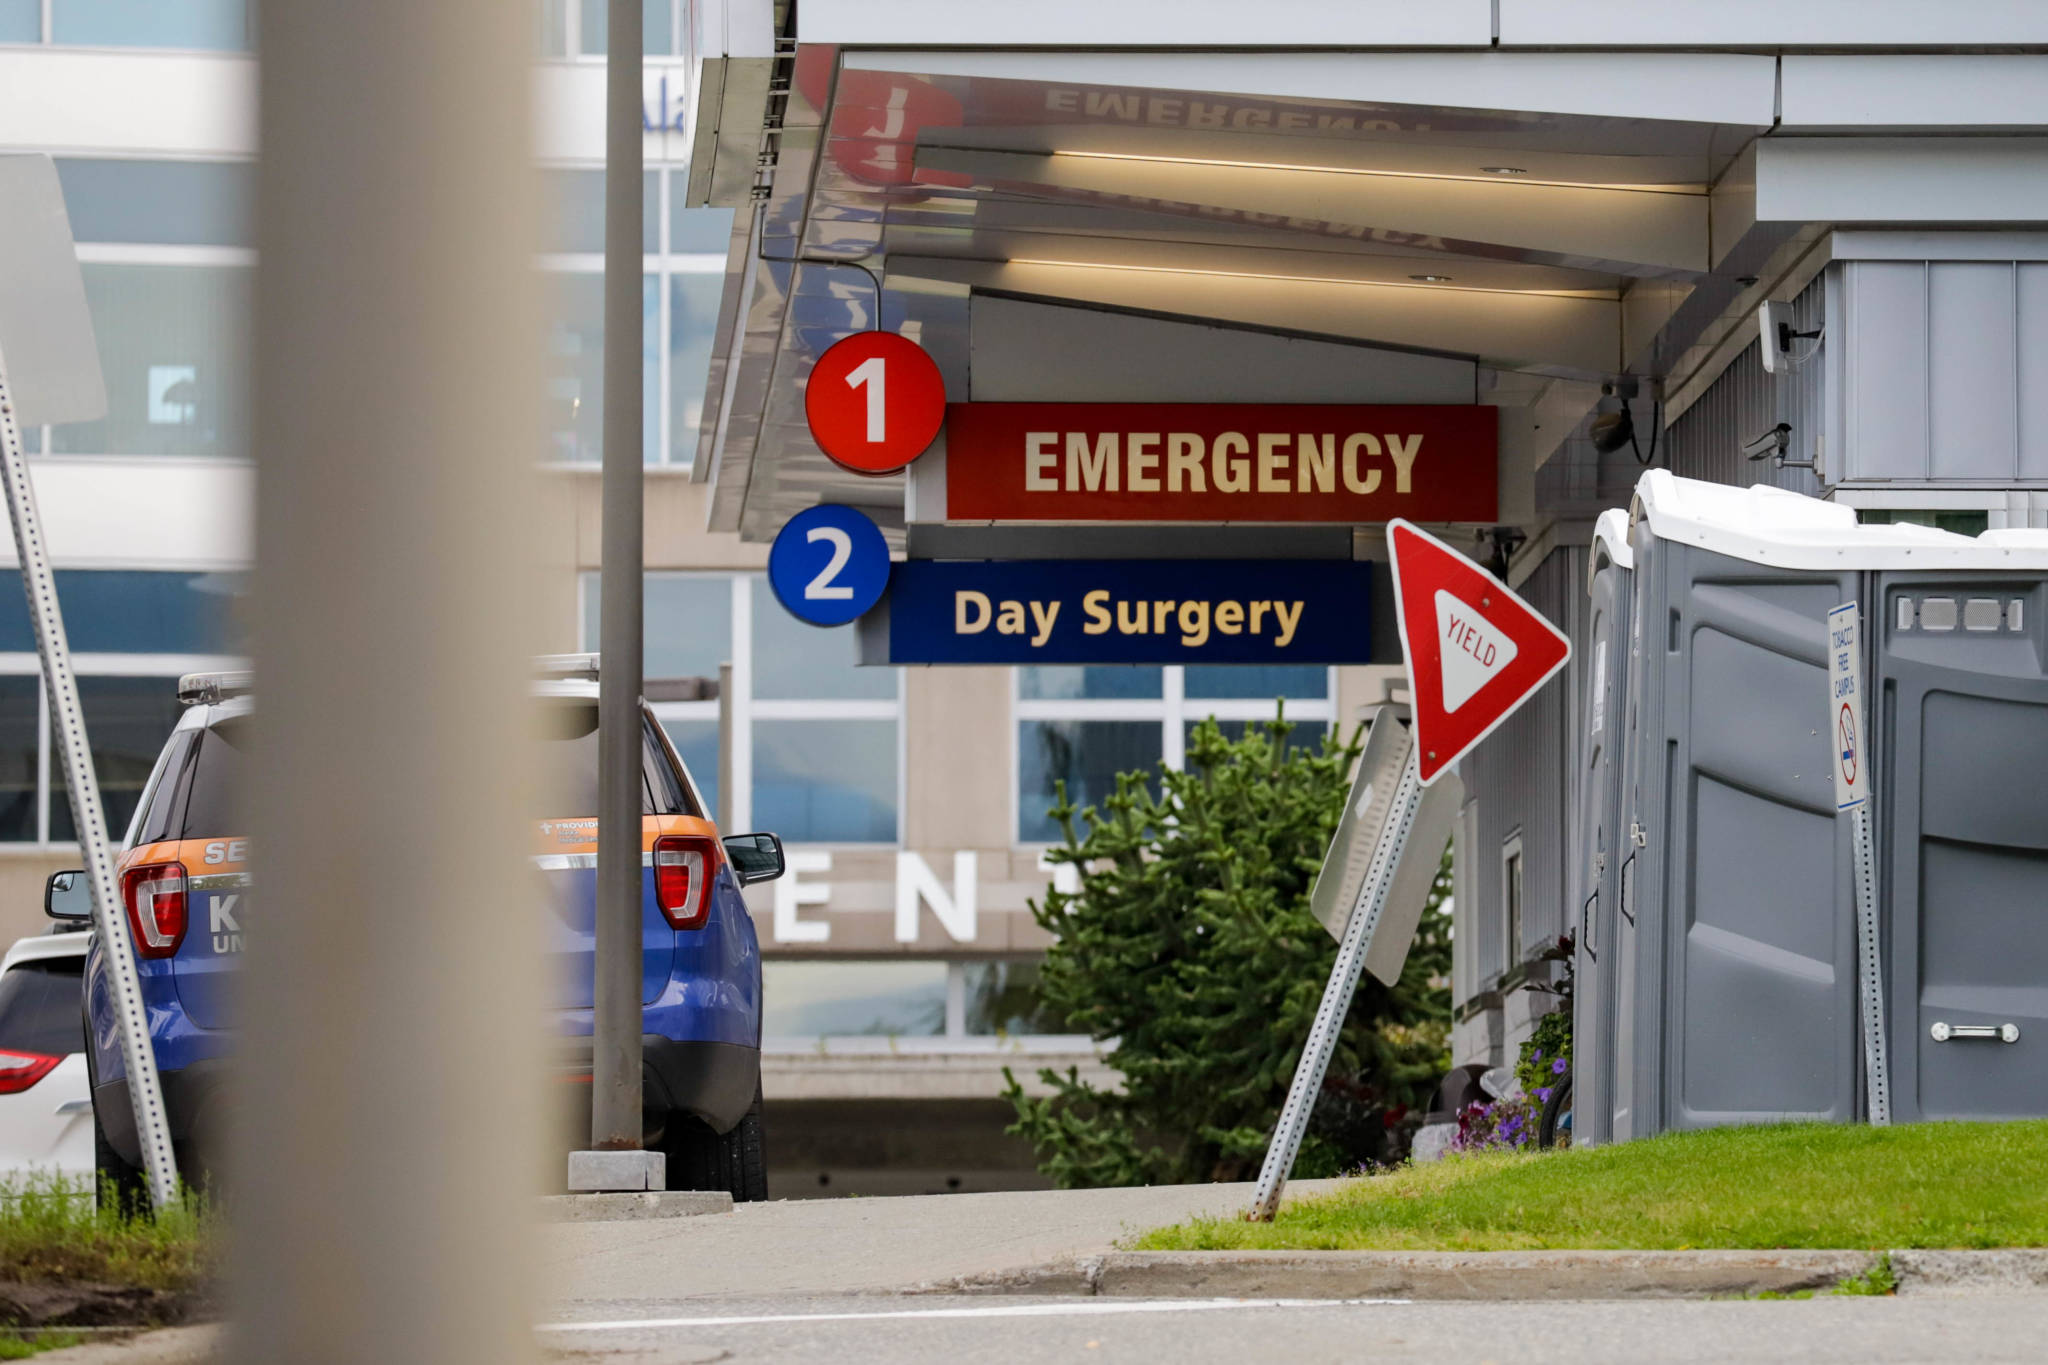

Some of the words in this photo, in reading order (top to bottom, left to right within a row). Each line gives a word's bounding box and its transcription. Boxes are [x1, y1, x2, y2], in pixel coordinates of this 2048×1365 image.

[844, 357, 886, 443] 1
[1025, 431, 1424, 495] EMERGENCY
[803, 526, 855, 600] 2
[954, 590, 1061, 647] Day
[1083, 590, 1305, 647] Surgery
[1447, 612, 1496, 668] YIELD
[1832, 625, 1854, 649] TOBACCO
[1835, 675, 1855, 699] CAMPUS
[1838, 652, 1849, 672] FREE
